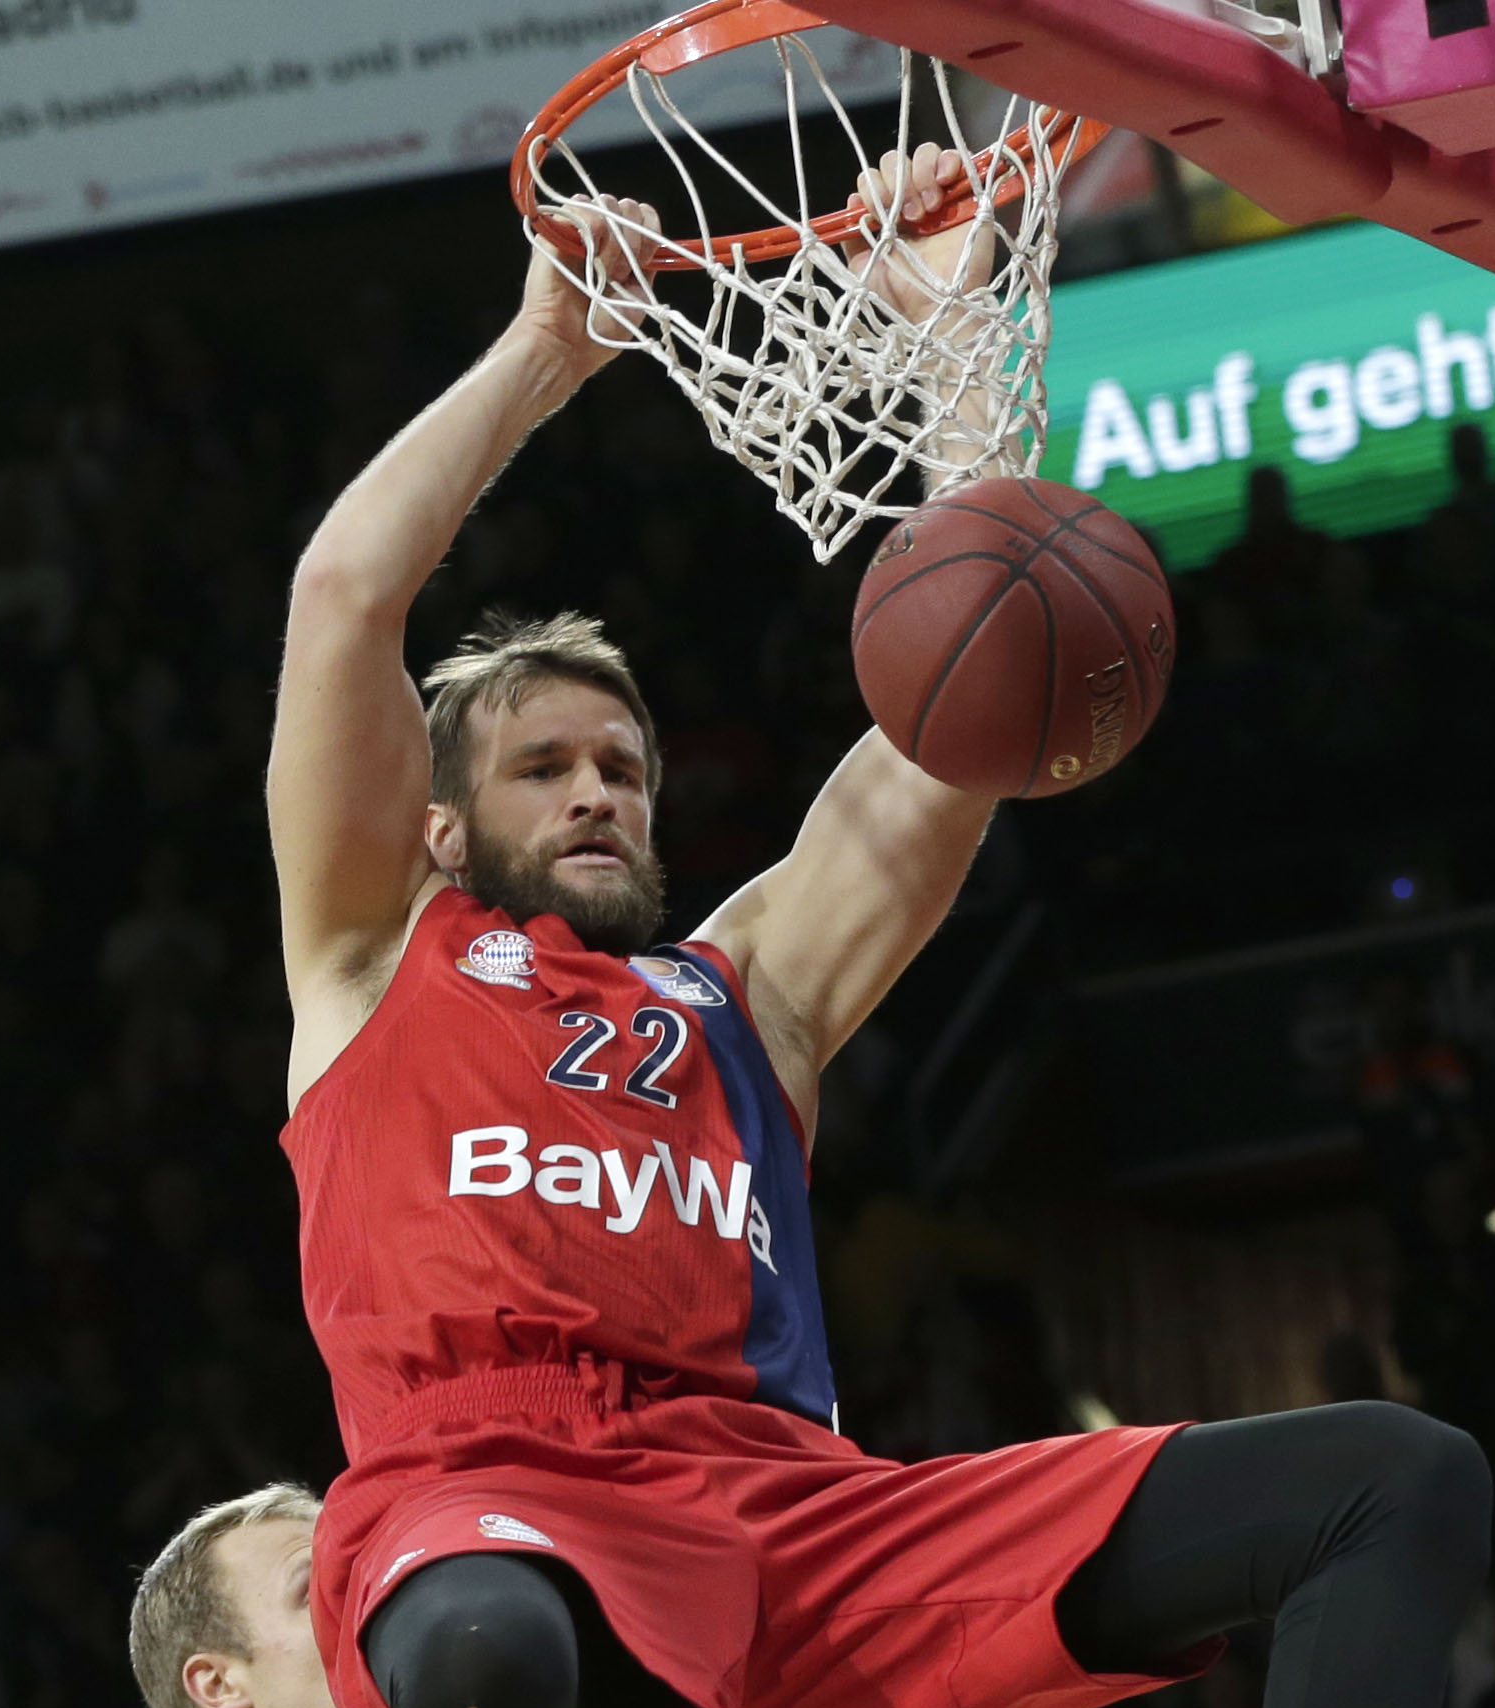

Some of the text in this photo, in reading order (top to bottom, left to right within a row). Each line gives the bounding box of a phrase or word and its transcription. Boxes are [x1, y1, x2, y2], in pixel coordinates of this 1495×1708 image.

[1072, 350, 1259, 490] Auf
[545, 1006, 688, 1110] 22
[448, 1124, 779, 1275] BayWa
